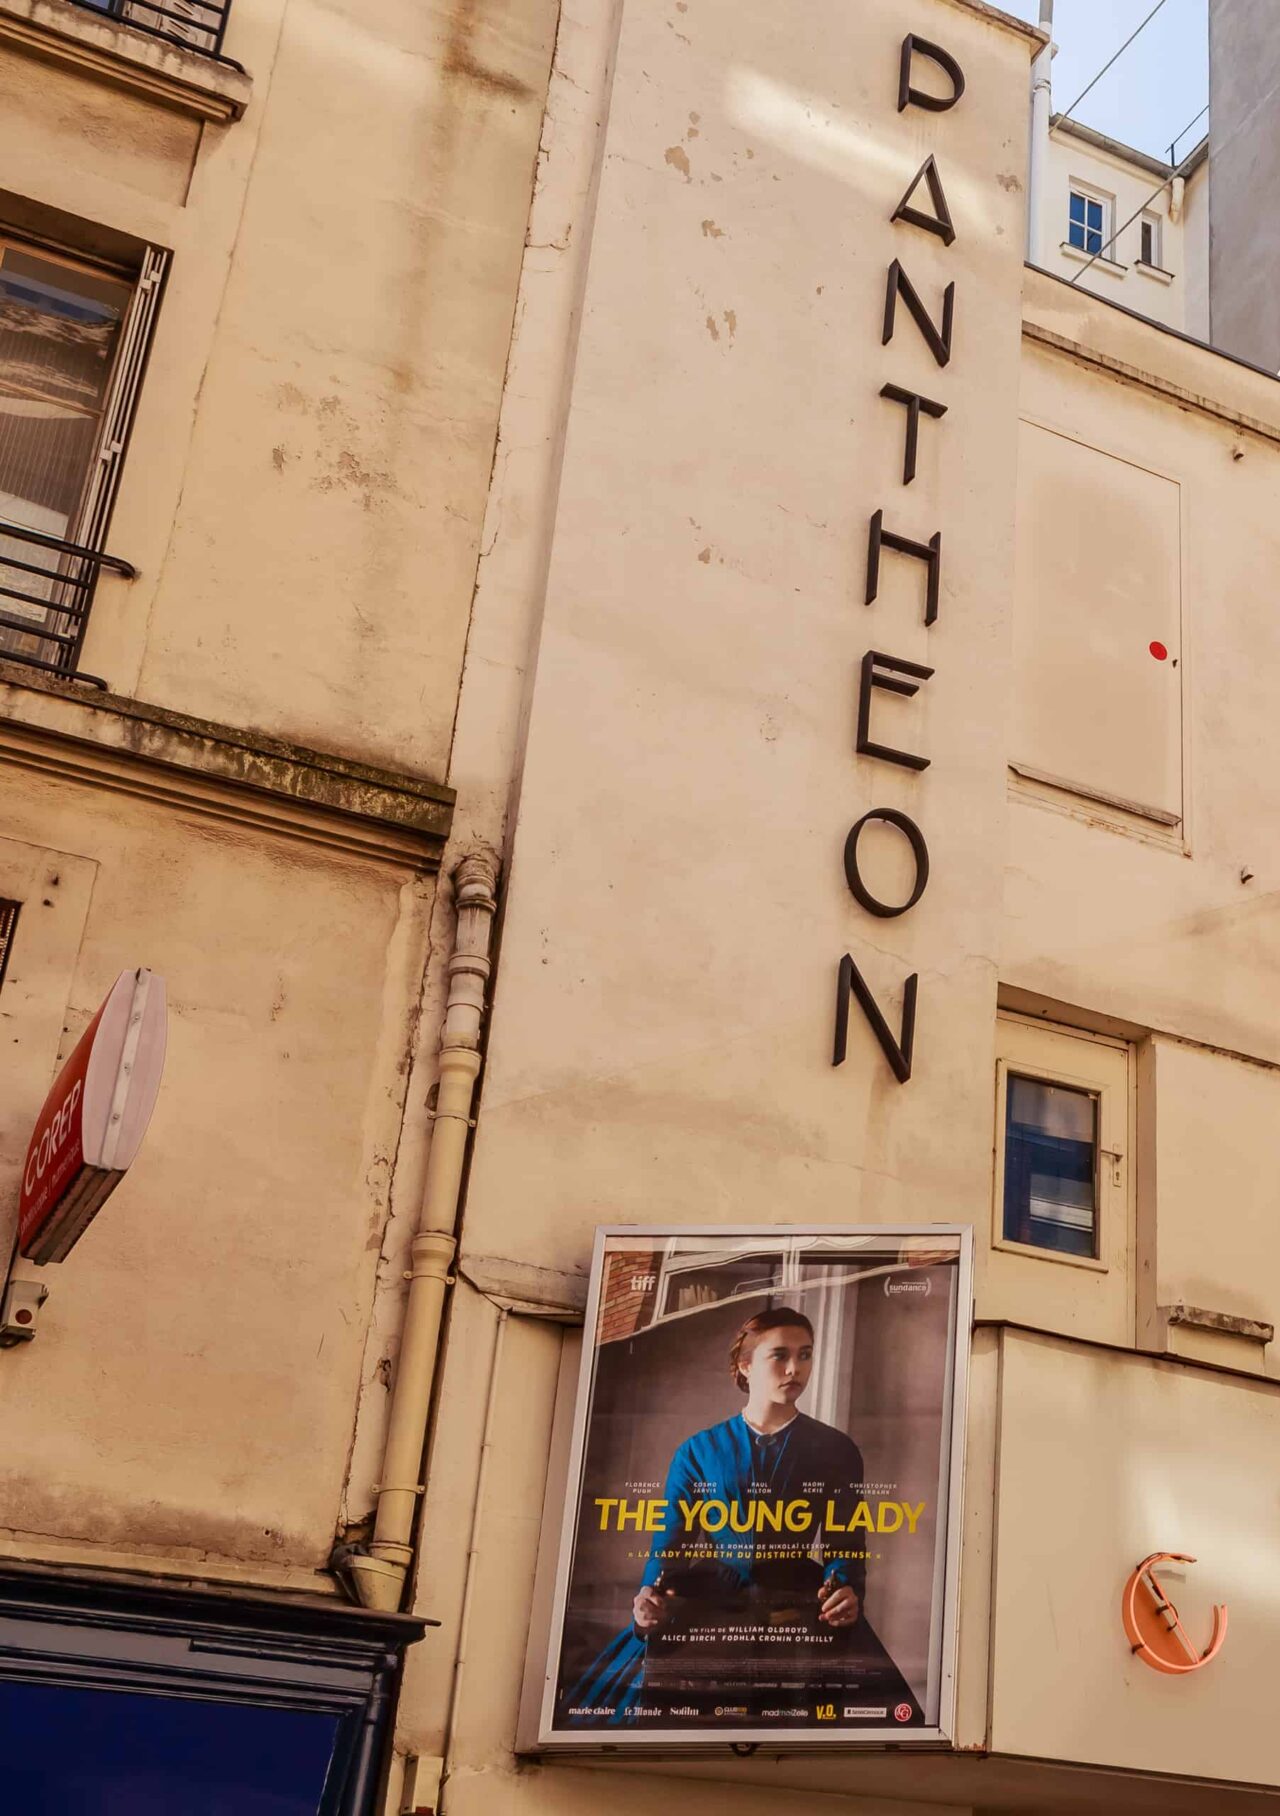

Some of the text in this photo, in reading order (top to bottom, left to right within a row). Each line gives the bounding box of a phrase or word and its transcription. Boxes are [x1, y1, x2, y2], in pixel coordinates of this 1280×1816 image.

[832, 33, 965, 1083] PANTHEON
[25, 1079, 81, 1197] COREP
[631, 1275, 655, 1291] tiff
[595, 1499, 926, 1533] THE YOUNG LADY
[654, 1550, 681, 1558] LADY
[684, 1550, 733, 1559] MACBETH
[737, 1551, 751, 1559] DU
[755, 1551, 802, 1559] DISTRICT
[823, 1551, 872, 1559] MTSENSK
[767, 1626, 808, 1634] OLDROYD
[661, 1634, 687, 1642] ALICE
[758, 1635, 792, 1643] CRONIN
[795, 1635, 834, 1643] O'REILLY
[568, 1706, 616, 1715] marie claire
[633, 1706, 662, 1716] Monde
[816, 1704, 837, 1720] V.O.
